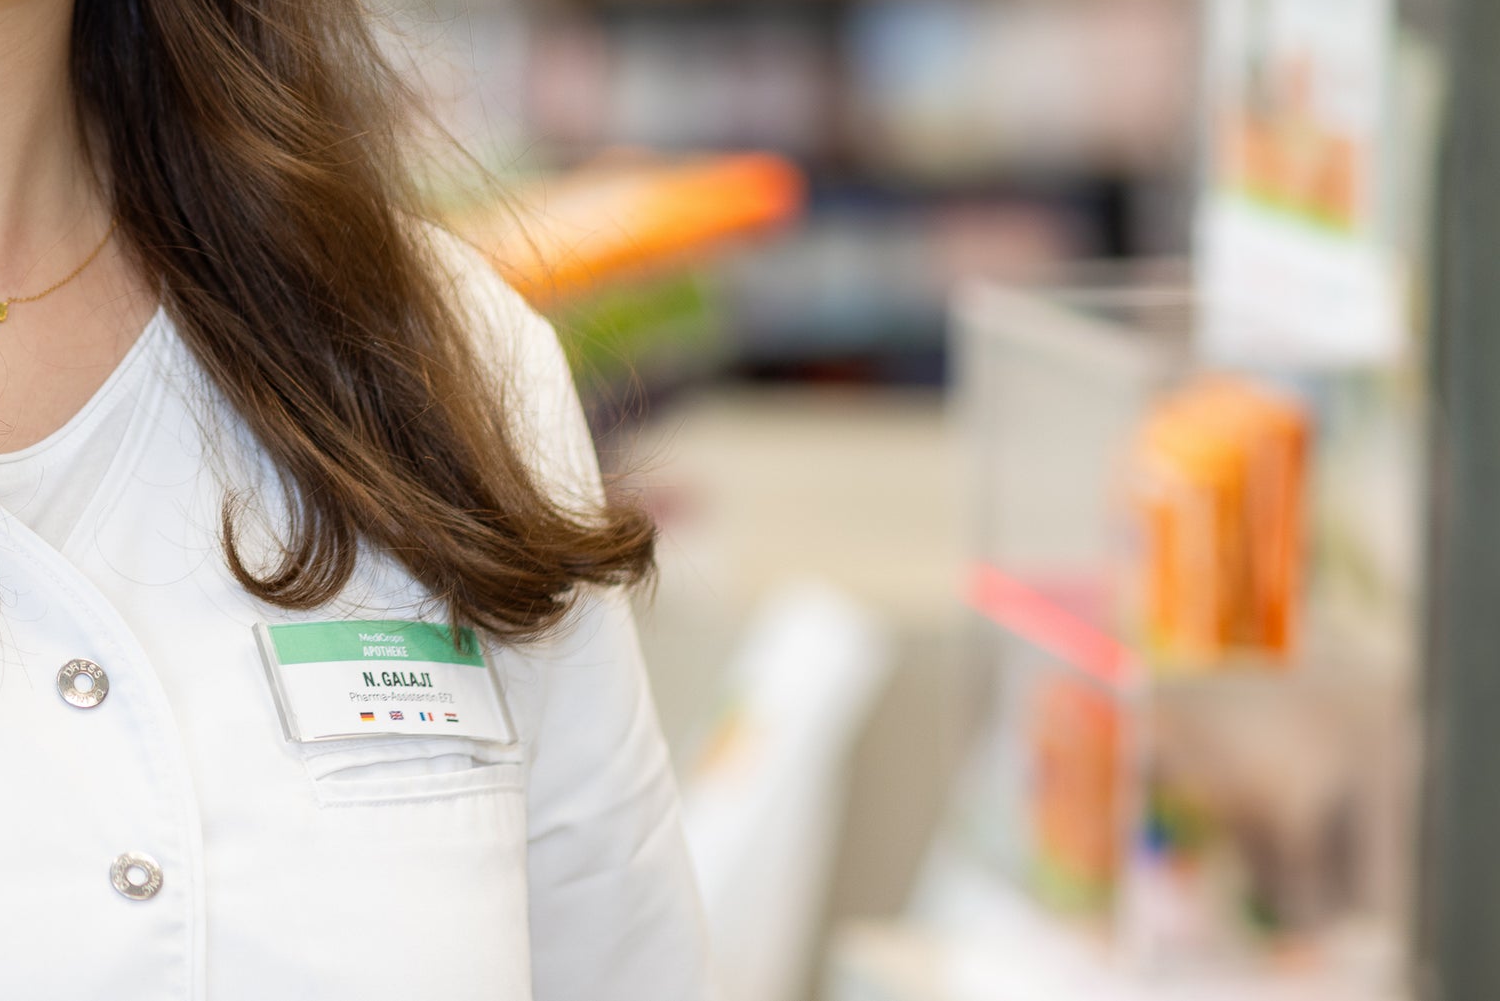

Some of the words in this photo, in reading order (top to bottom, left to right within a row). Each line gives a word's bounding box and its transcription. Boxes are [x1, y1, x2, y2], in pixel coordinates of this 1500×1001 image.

[363, 645, 409, 657] APOTHEKE
[63, 660, 102, 678] DRESS
[363, 671, 380, 687] N.
[382, 672, 433, 688] GALAJI
